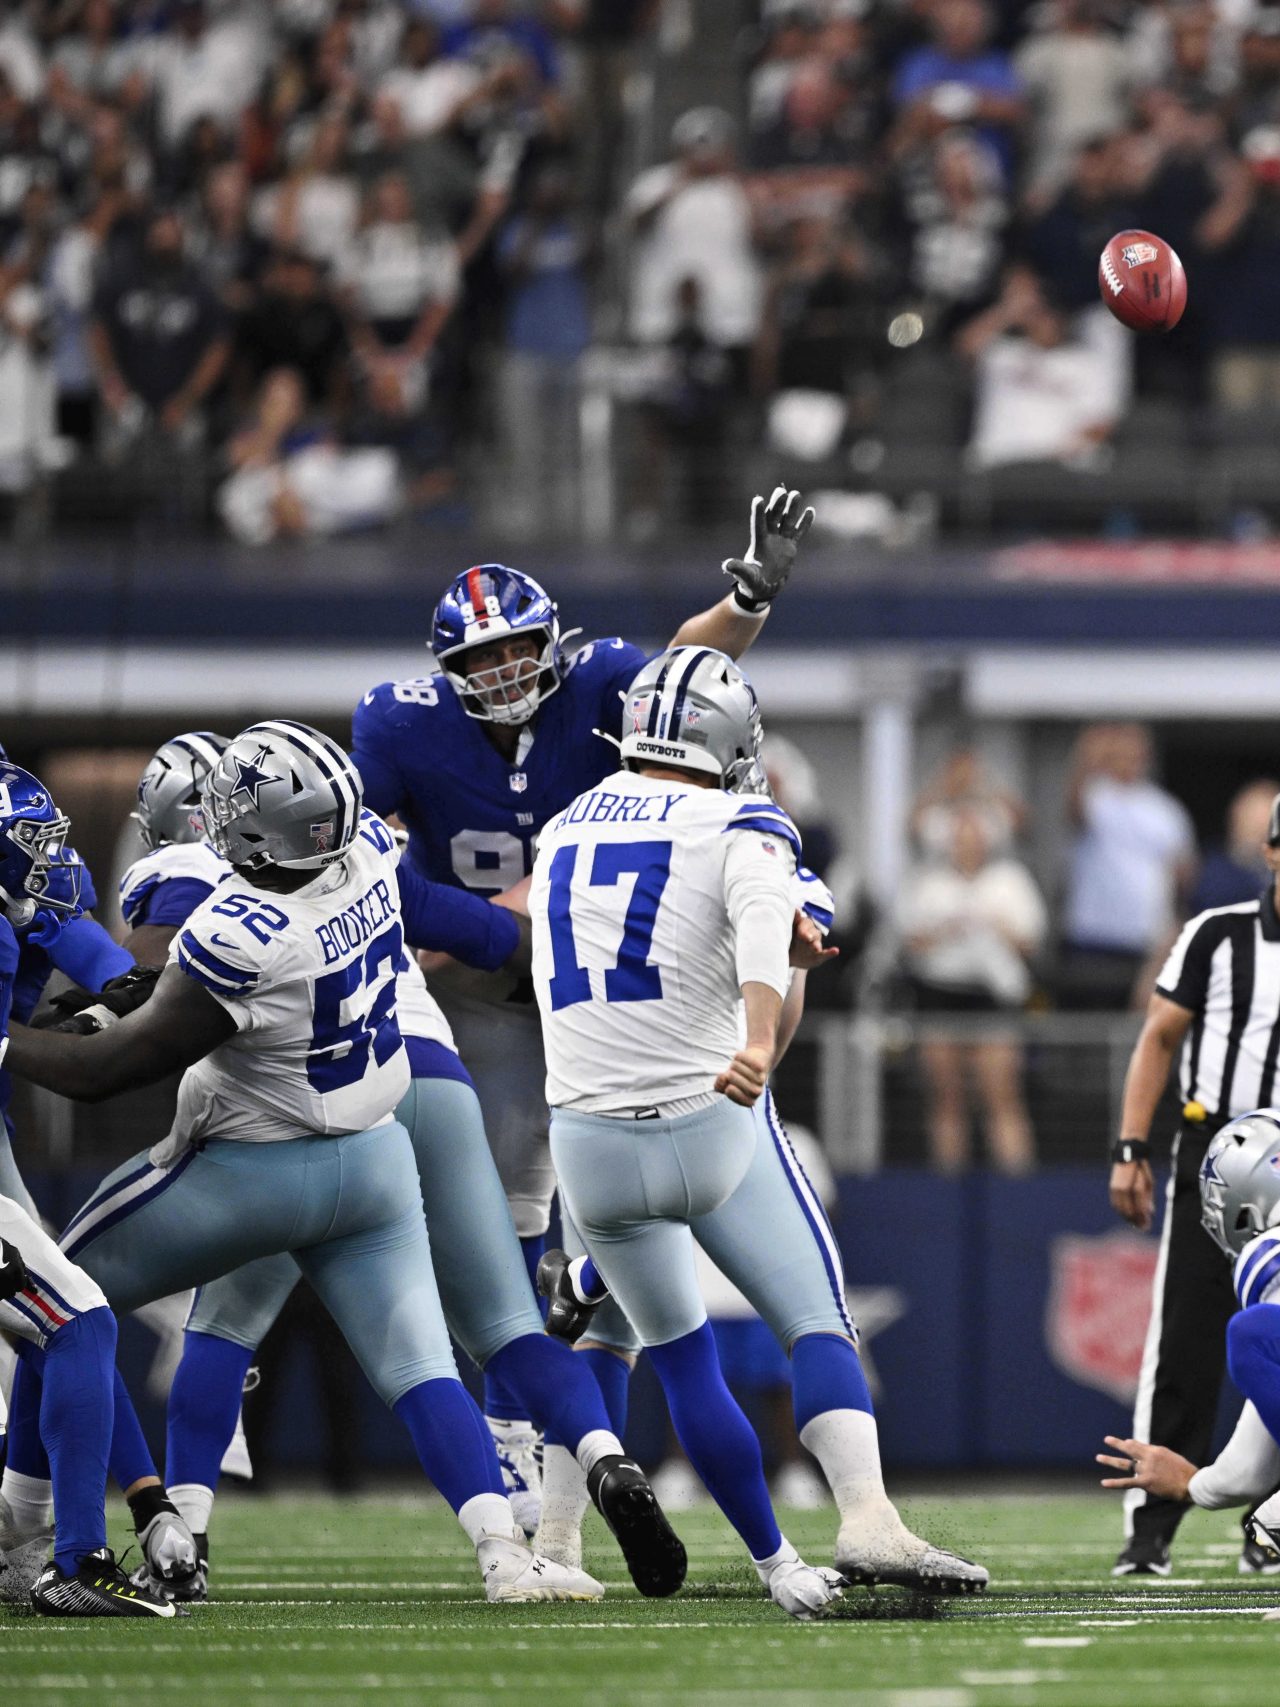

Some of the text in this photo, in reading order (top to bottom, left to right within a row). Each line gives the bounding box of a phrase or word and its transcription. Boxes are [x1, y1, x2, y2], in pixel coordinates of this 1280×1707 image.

[460, 595, 502, 625] 98
[636, 742, 687, 759] COWBOYS
[553, 790, 688, 832] AUBREY
[211, 893, 291, 946] 52
[315, 878, 396, 966] BOOKER
[547, 840, 674, 1013] 17
[306, 921, 403, 1095] 52
